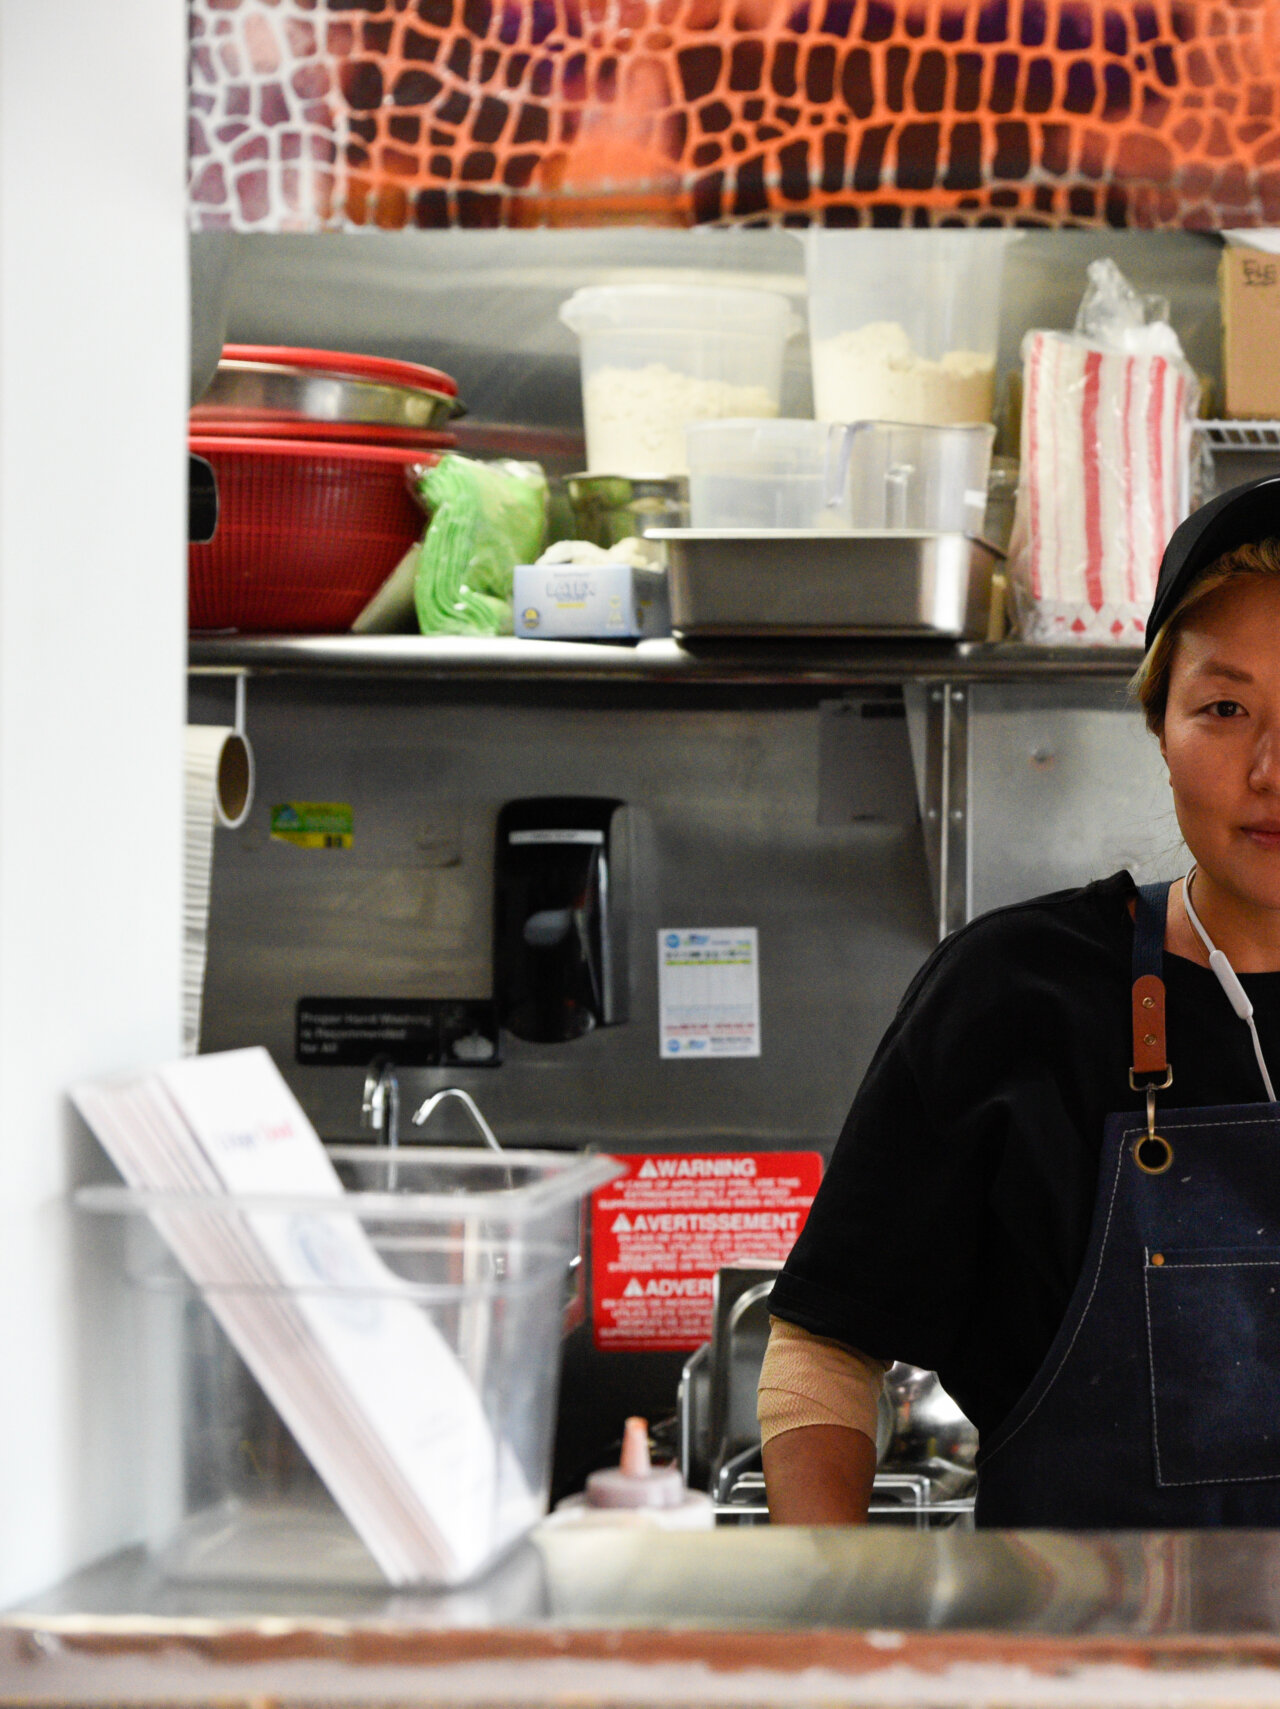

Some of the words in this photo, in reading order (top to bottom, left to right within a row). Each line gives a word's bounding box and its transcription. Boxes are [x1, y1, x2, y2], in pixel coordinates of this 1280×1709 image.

[657, 1158, 757, 1177] WARNING
[633, 1212, 800, 1231] AVERTISSEMENT
[645, 1278, 714, 1296] ADVER
